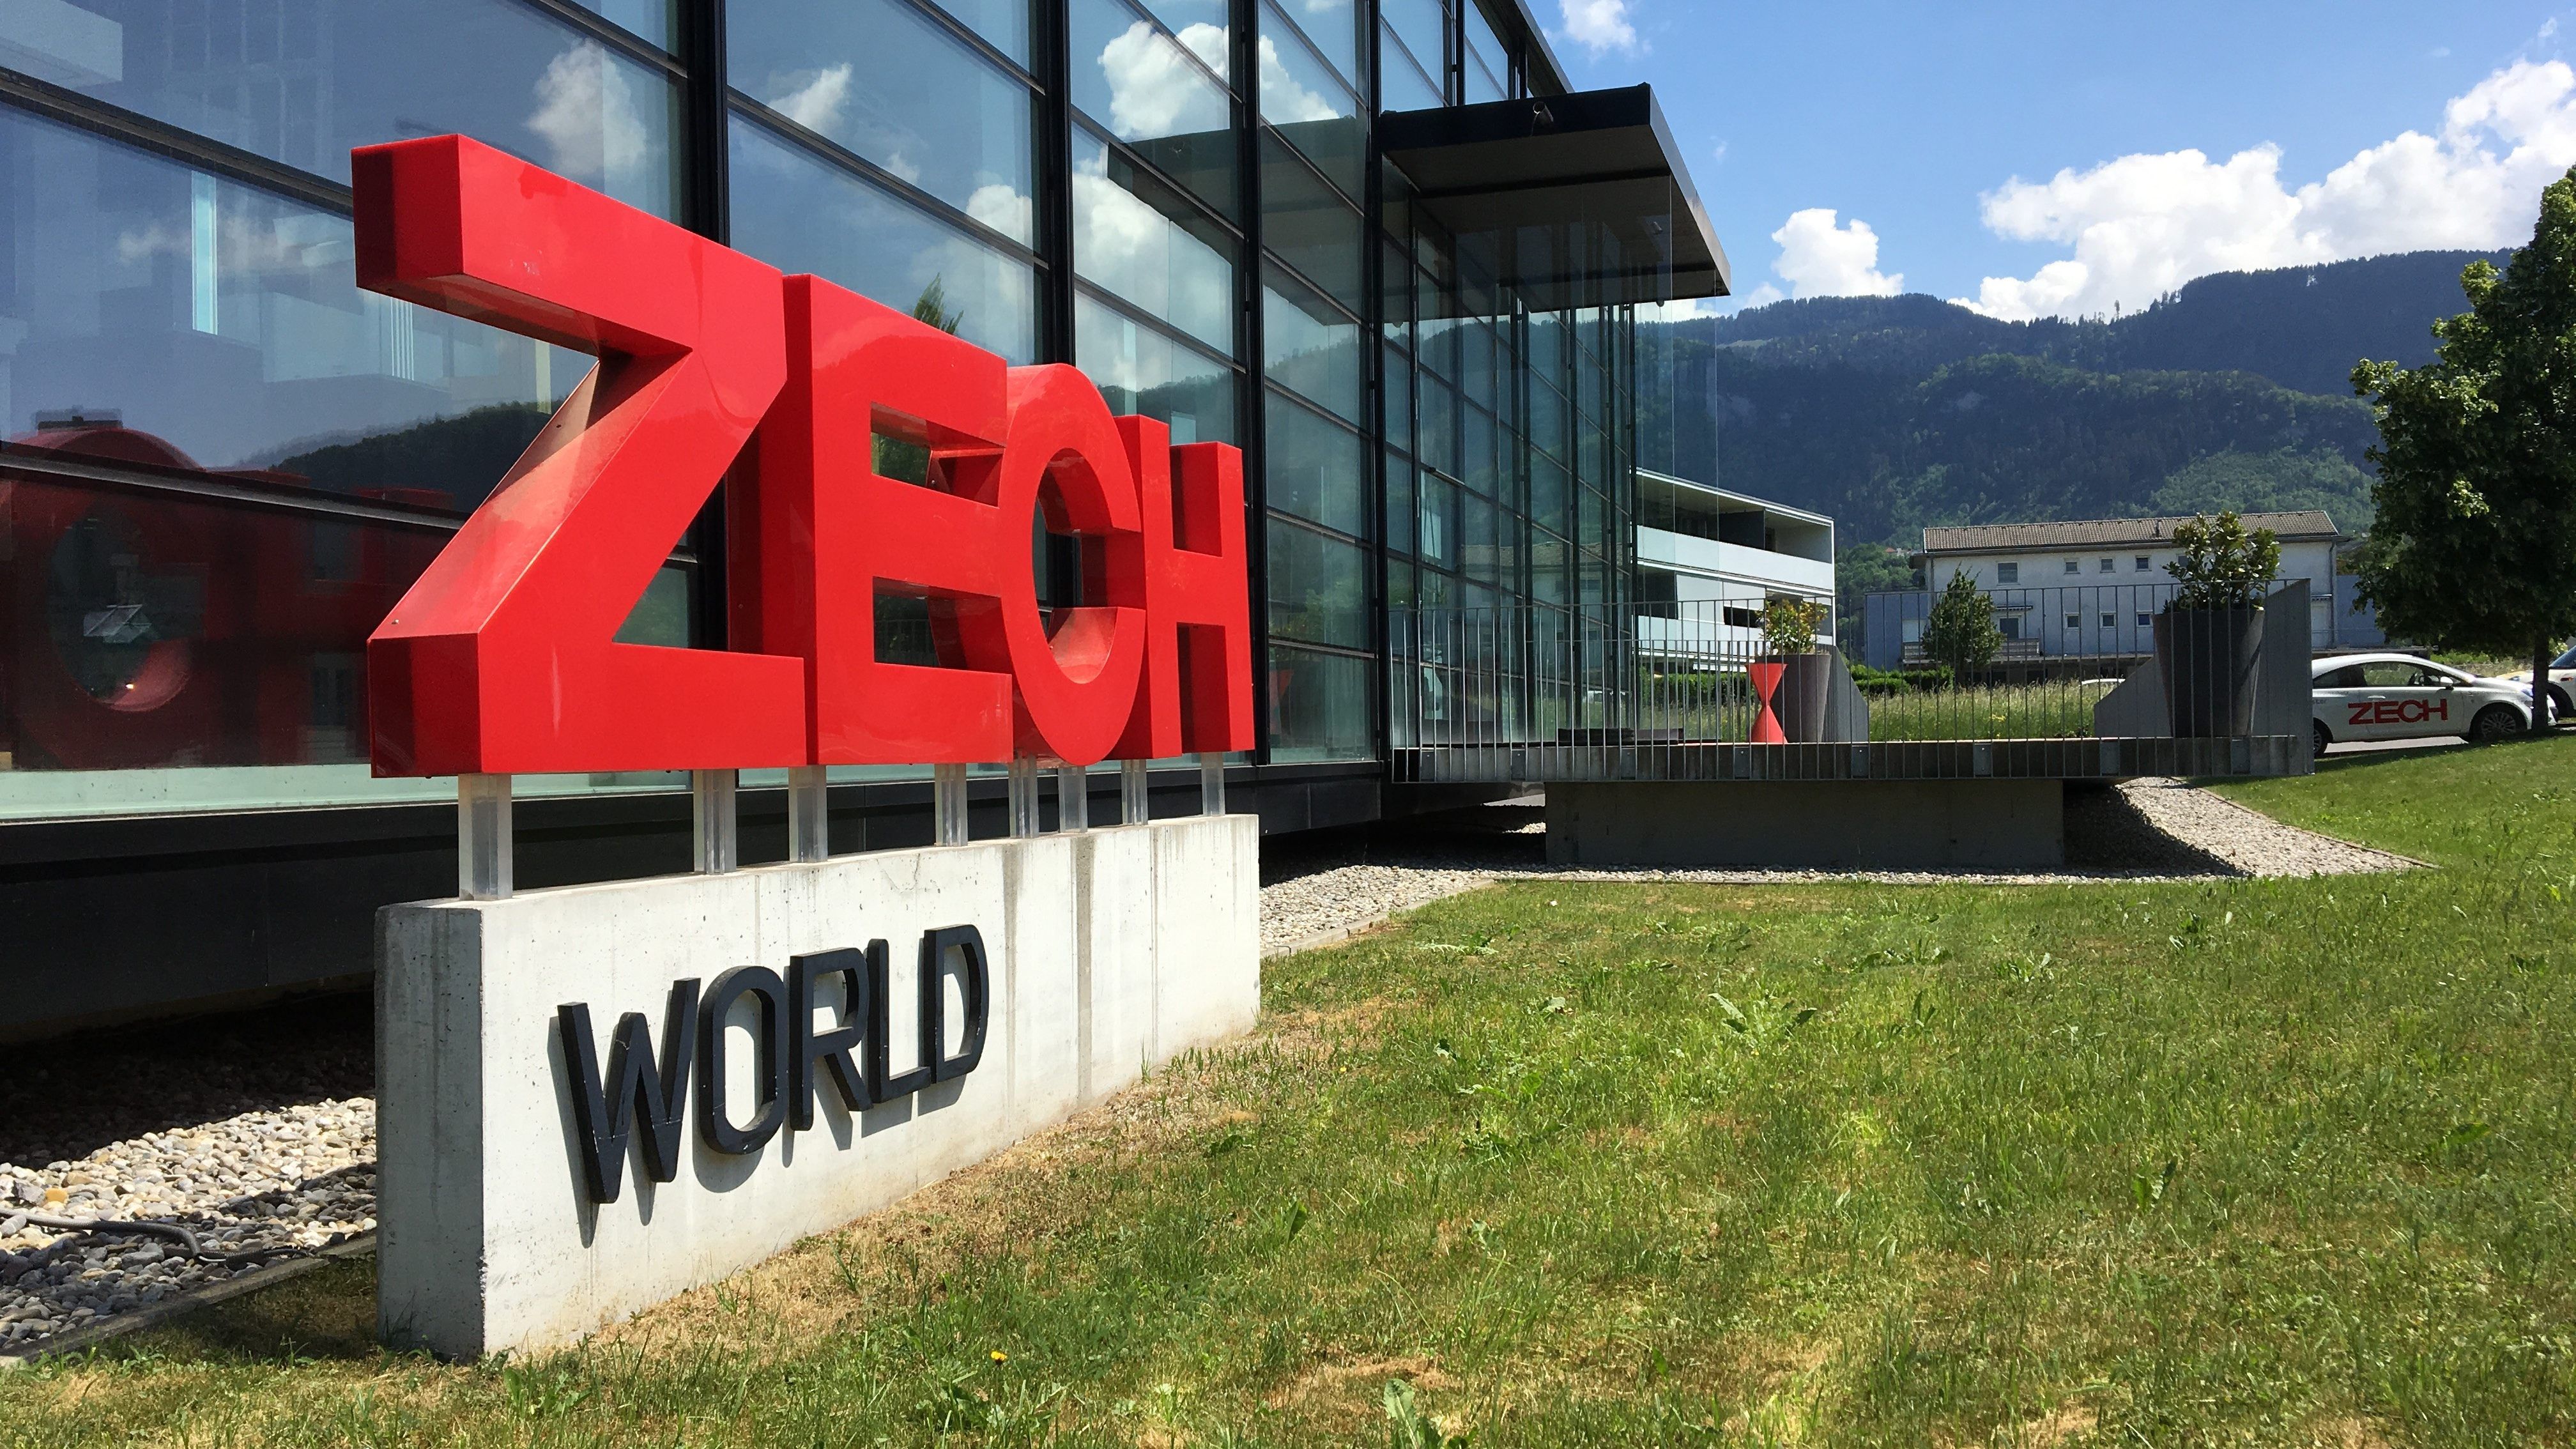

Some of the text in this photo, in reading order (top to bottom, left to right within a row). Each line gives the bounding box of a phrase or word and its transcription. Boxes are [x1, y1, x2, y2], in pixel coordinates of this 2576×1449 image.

[351, 134, 1254, 778] ZECH
[2347, 698, 2448, 725] ZECH
[557, 924, 989, 1204] WORLD
